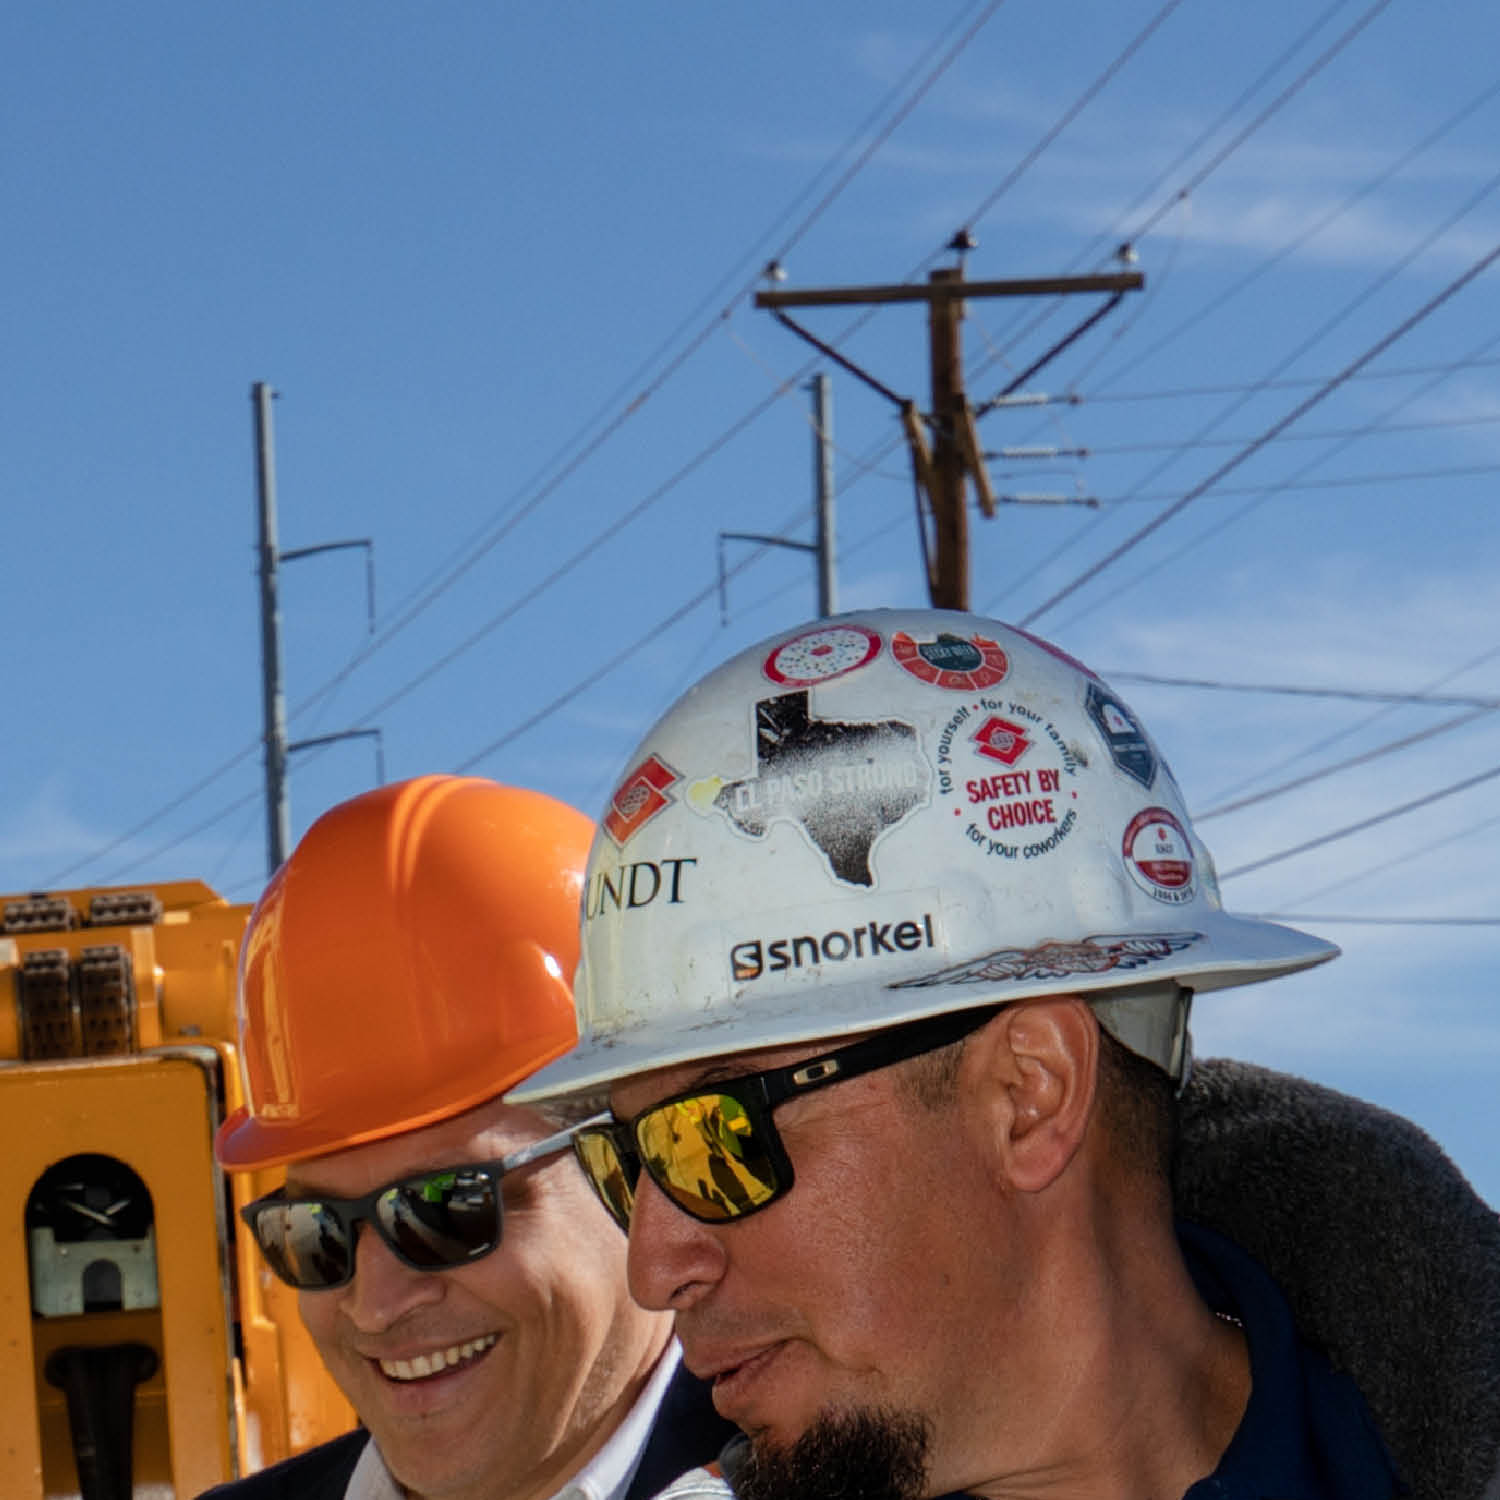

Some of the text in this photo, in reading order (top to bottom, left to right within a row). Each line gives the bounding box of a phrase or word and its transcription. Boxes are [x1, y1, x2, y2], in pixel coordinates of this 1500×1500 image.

[938, 705, 972, 796] for yourself
[980, 697, 1077, 777] for your family
[966, 768, 1061, 804] SAFETY BY
[965, 808, 1078, 860] for your coworkers
[988, 799, 1058, 832] CHOICE
[769, 914, 935, 972] snorkel
